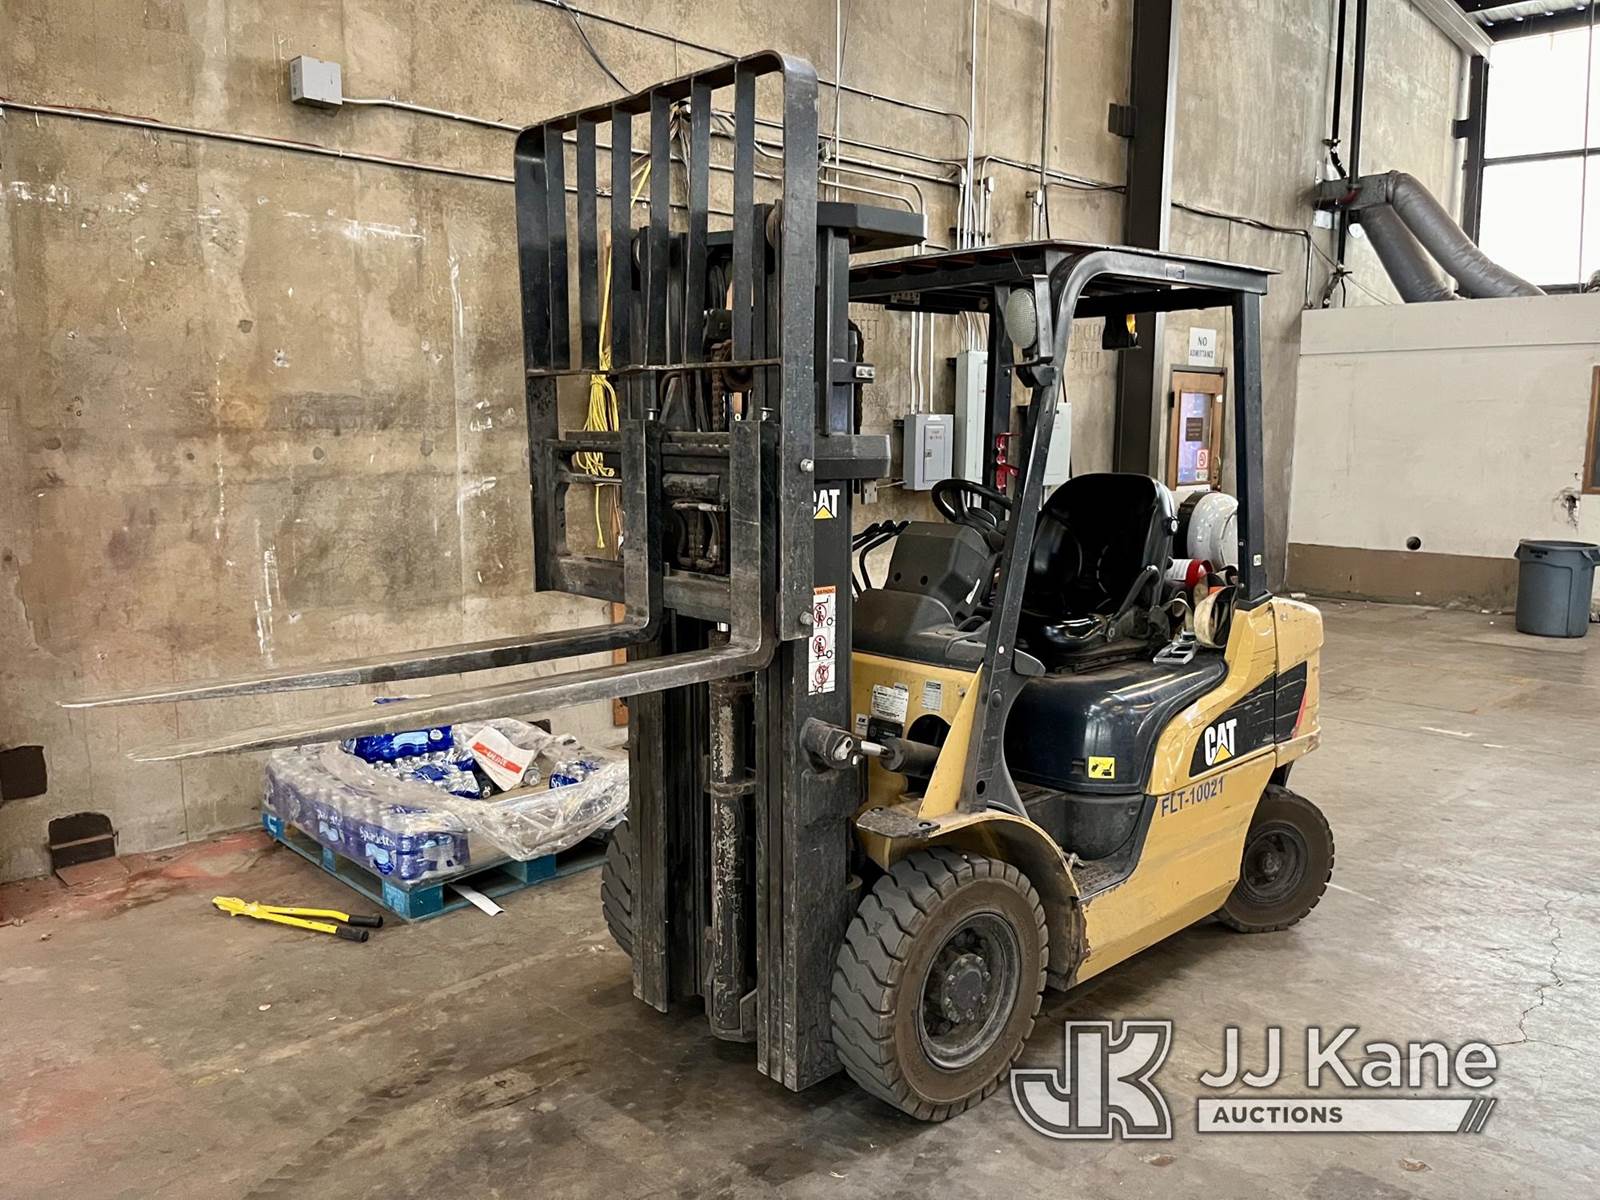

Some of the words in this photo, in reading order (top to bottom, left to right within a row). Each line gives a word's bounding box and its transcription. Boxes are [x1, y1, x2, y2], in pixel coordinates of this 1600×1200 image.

[1198, 336, 1208, 347] NO
[1204, 718, 1237, 766] CAT
[1161, 776, 1225, 818] FLT-10021
